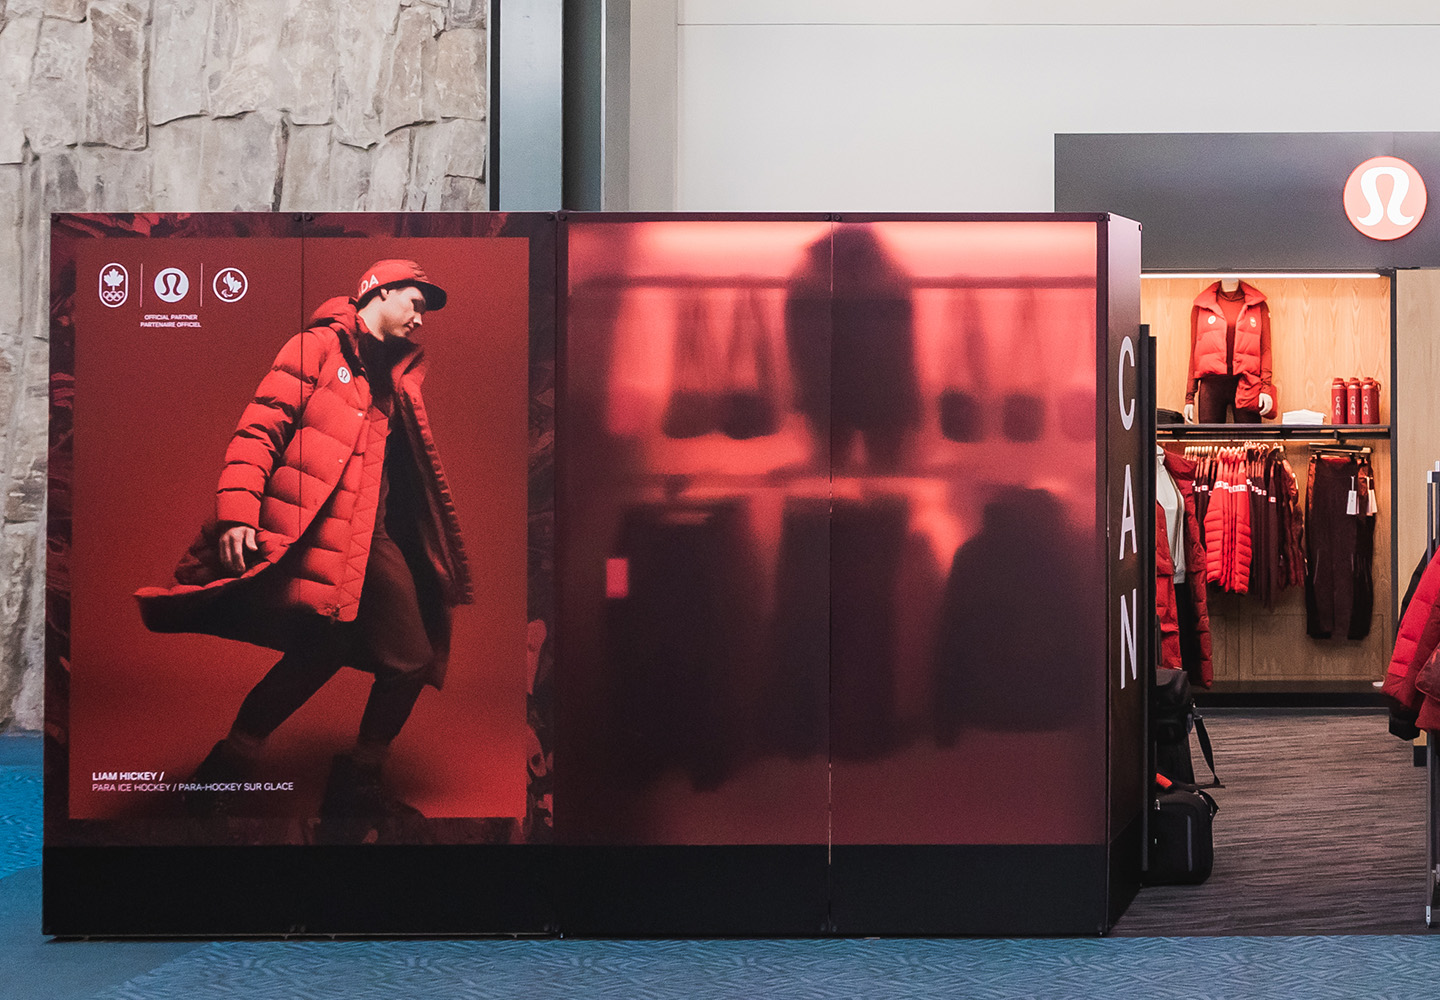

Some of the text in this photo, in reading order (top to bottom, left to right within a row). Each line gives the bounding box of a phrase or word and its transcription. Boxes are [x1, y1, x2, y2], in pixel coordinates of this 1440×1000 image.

[359, 274, 379, 296] DA
[1118, 335, 1138, 690] CAN
[92, 771, 118, 781] LIAM
[119, 771, 158, 781] HICKEY
[92, 783, 117, 792] PARA
[117, 783, 133, 792] ICE
[133, 783, 171, 792] HOCKEY
[178, 782, 242, 792] PARA-HOCKEY
[243, 782, 262, 791] SUR
[263, 781, 294, 791] GLACE
